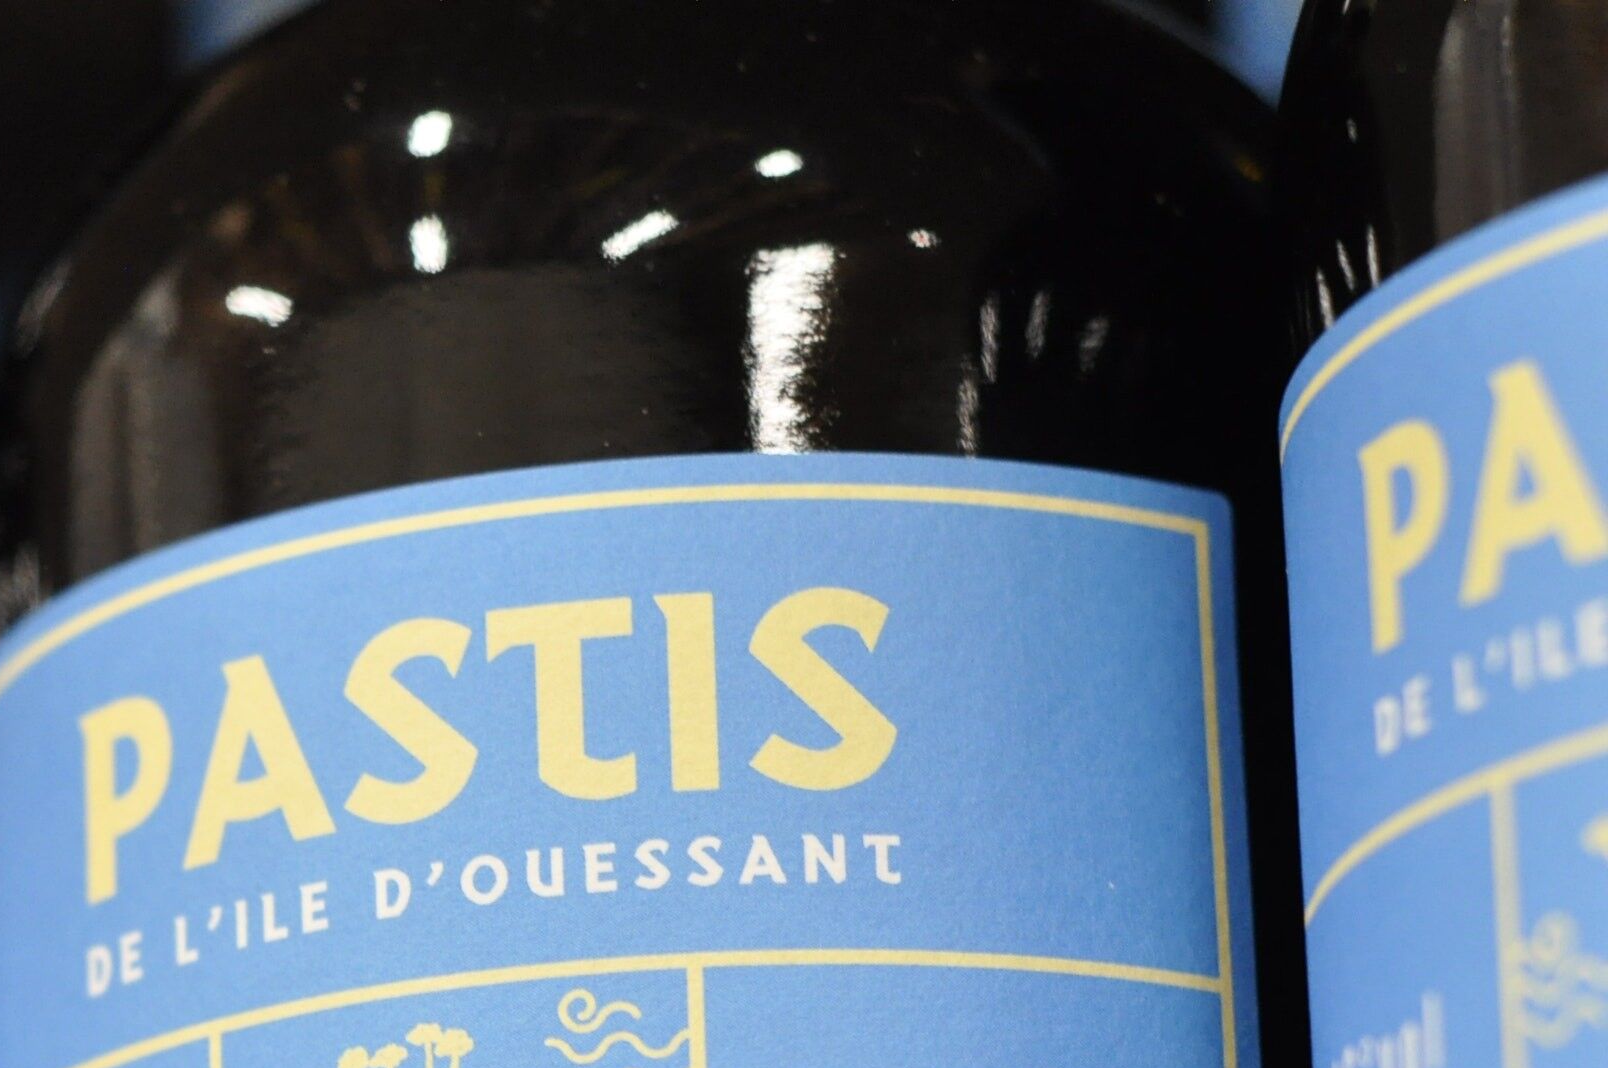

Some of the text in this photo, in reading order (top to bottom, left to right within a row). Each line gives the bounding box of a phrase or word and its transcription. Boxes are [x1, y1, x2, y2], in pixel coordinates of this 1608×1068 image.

[79, 586, 898, 905] PASTIS
[86, 833, 902, 998] DE L'ILE D'OUESSANT
